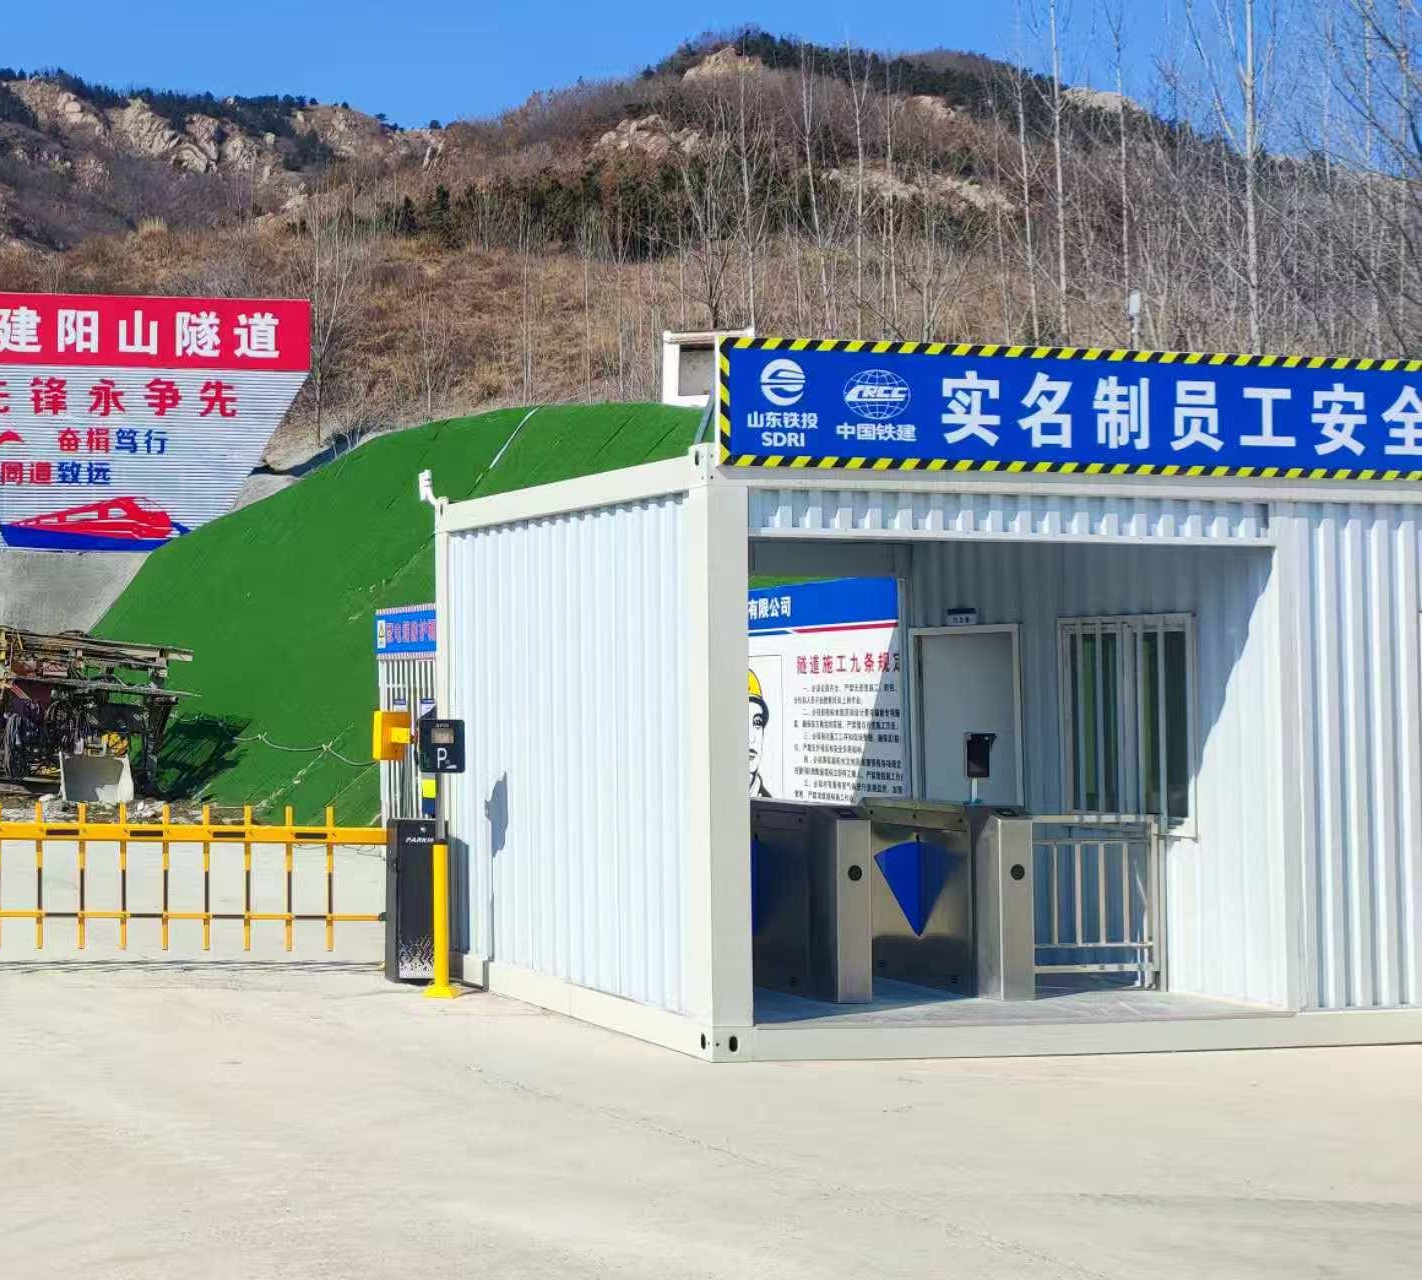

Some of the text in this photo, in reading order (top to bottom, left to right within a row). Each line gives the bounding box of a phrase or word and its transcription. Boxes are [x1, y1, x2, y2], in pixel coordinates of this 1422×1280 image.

[747, 411, 819, 430] 山东铁投
[942, 371, 1422, 456] 实名制员工安全
[761, 431, 805, 448] SDRI
[836, 422, 918, 442] 中国铁建
[748, 595, 791, 620] 有限公司
[796, 651, 900, 674] 隧道施工九条规定
